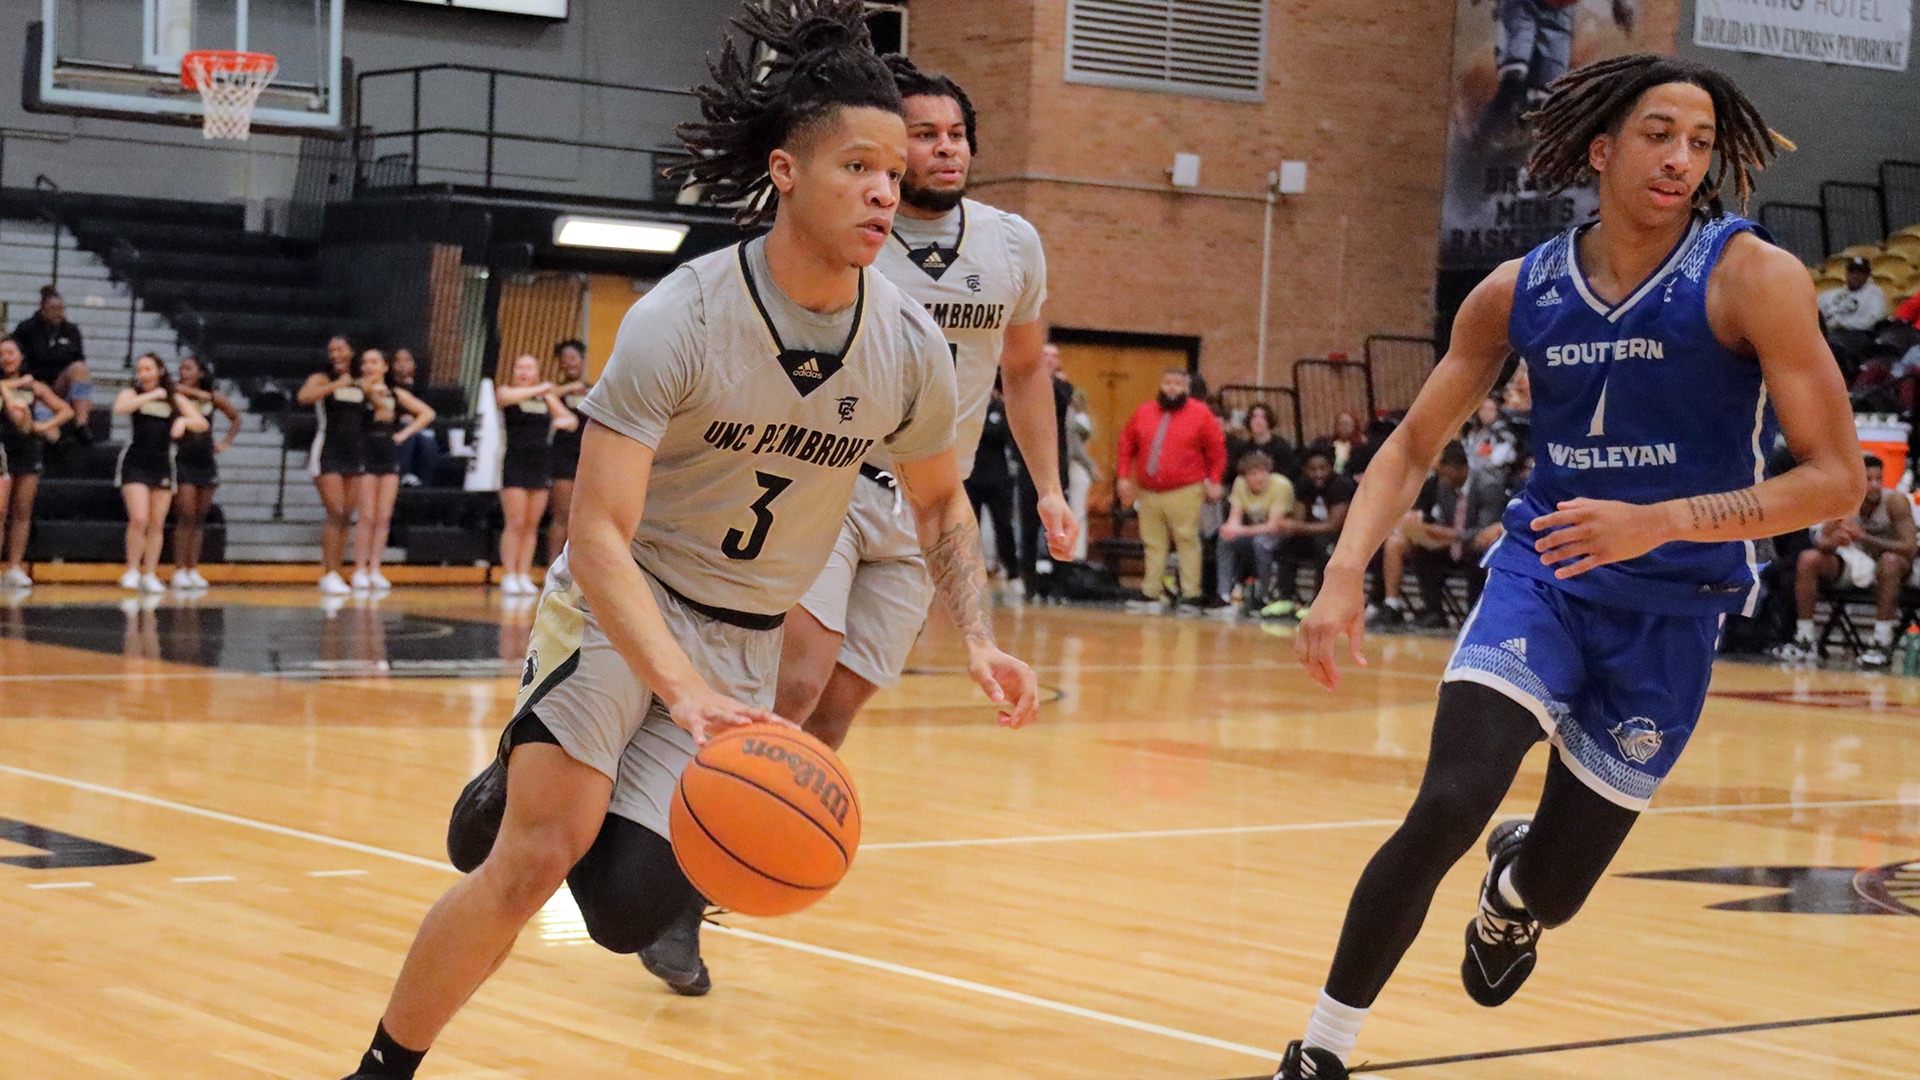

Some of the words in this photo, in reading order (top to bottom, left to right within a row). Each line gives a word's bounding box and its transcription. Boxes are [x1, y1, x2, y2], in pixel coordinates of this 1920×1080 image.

[923, 303, 1005, 329] MBROKE
[1545, 337, 1664, 366] SOUTERN
[792, 369, 823, 379] adidas
[703, 420, 755, 452] UNC
[720, 470, 794, 561] 3
[742, 738, 850, 828] Wilson
